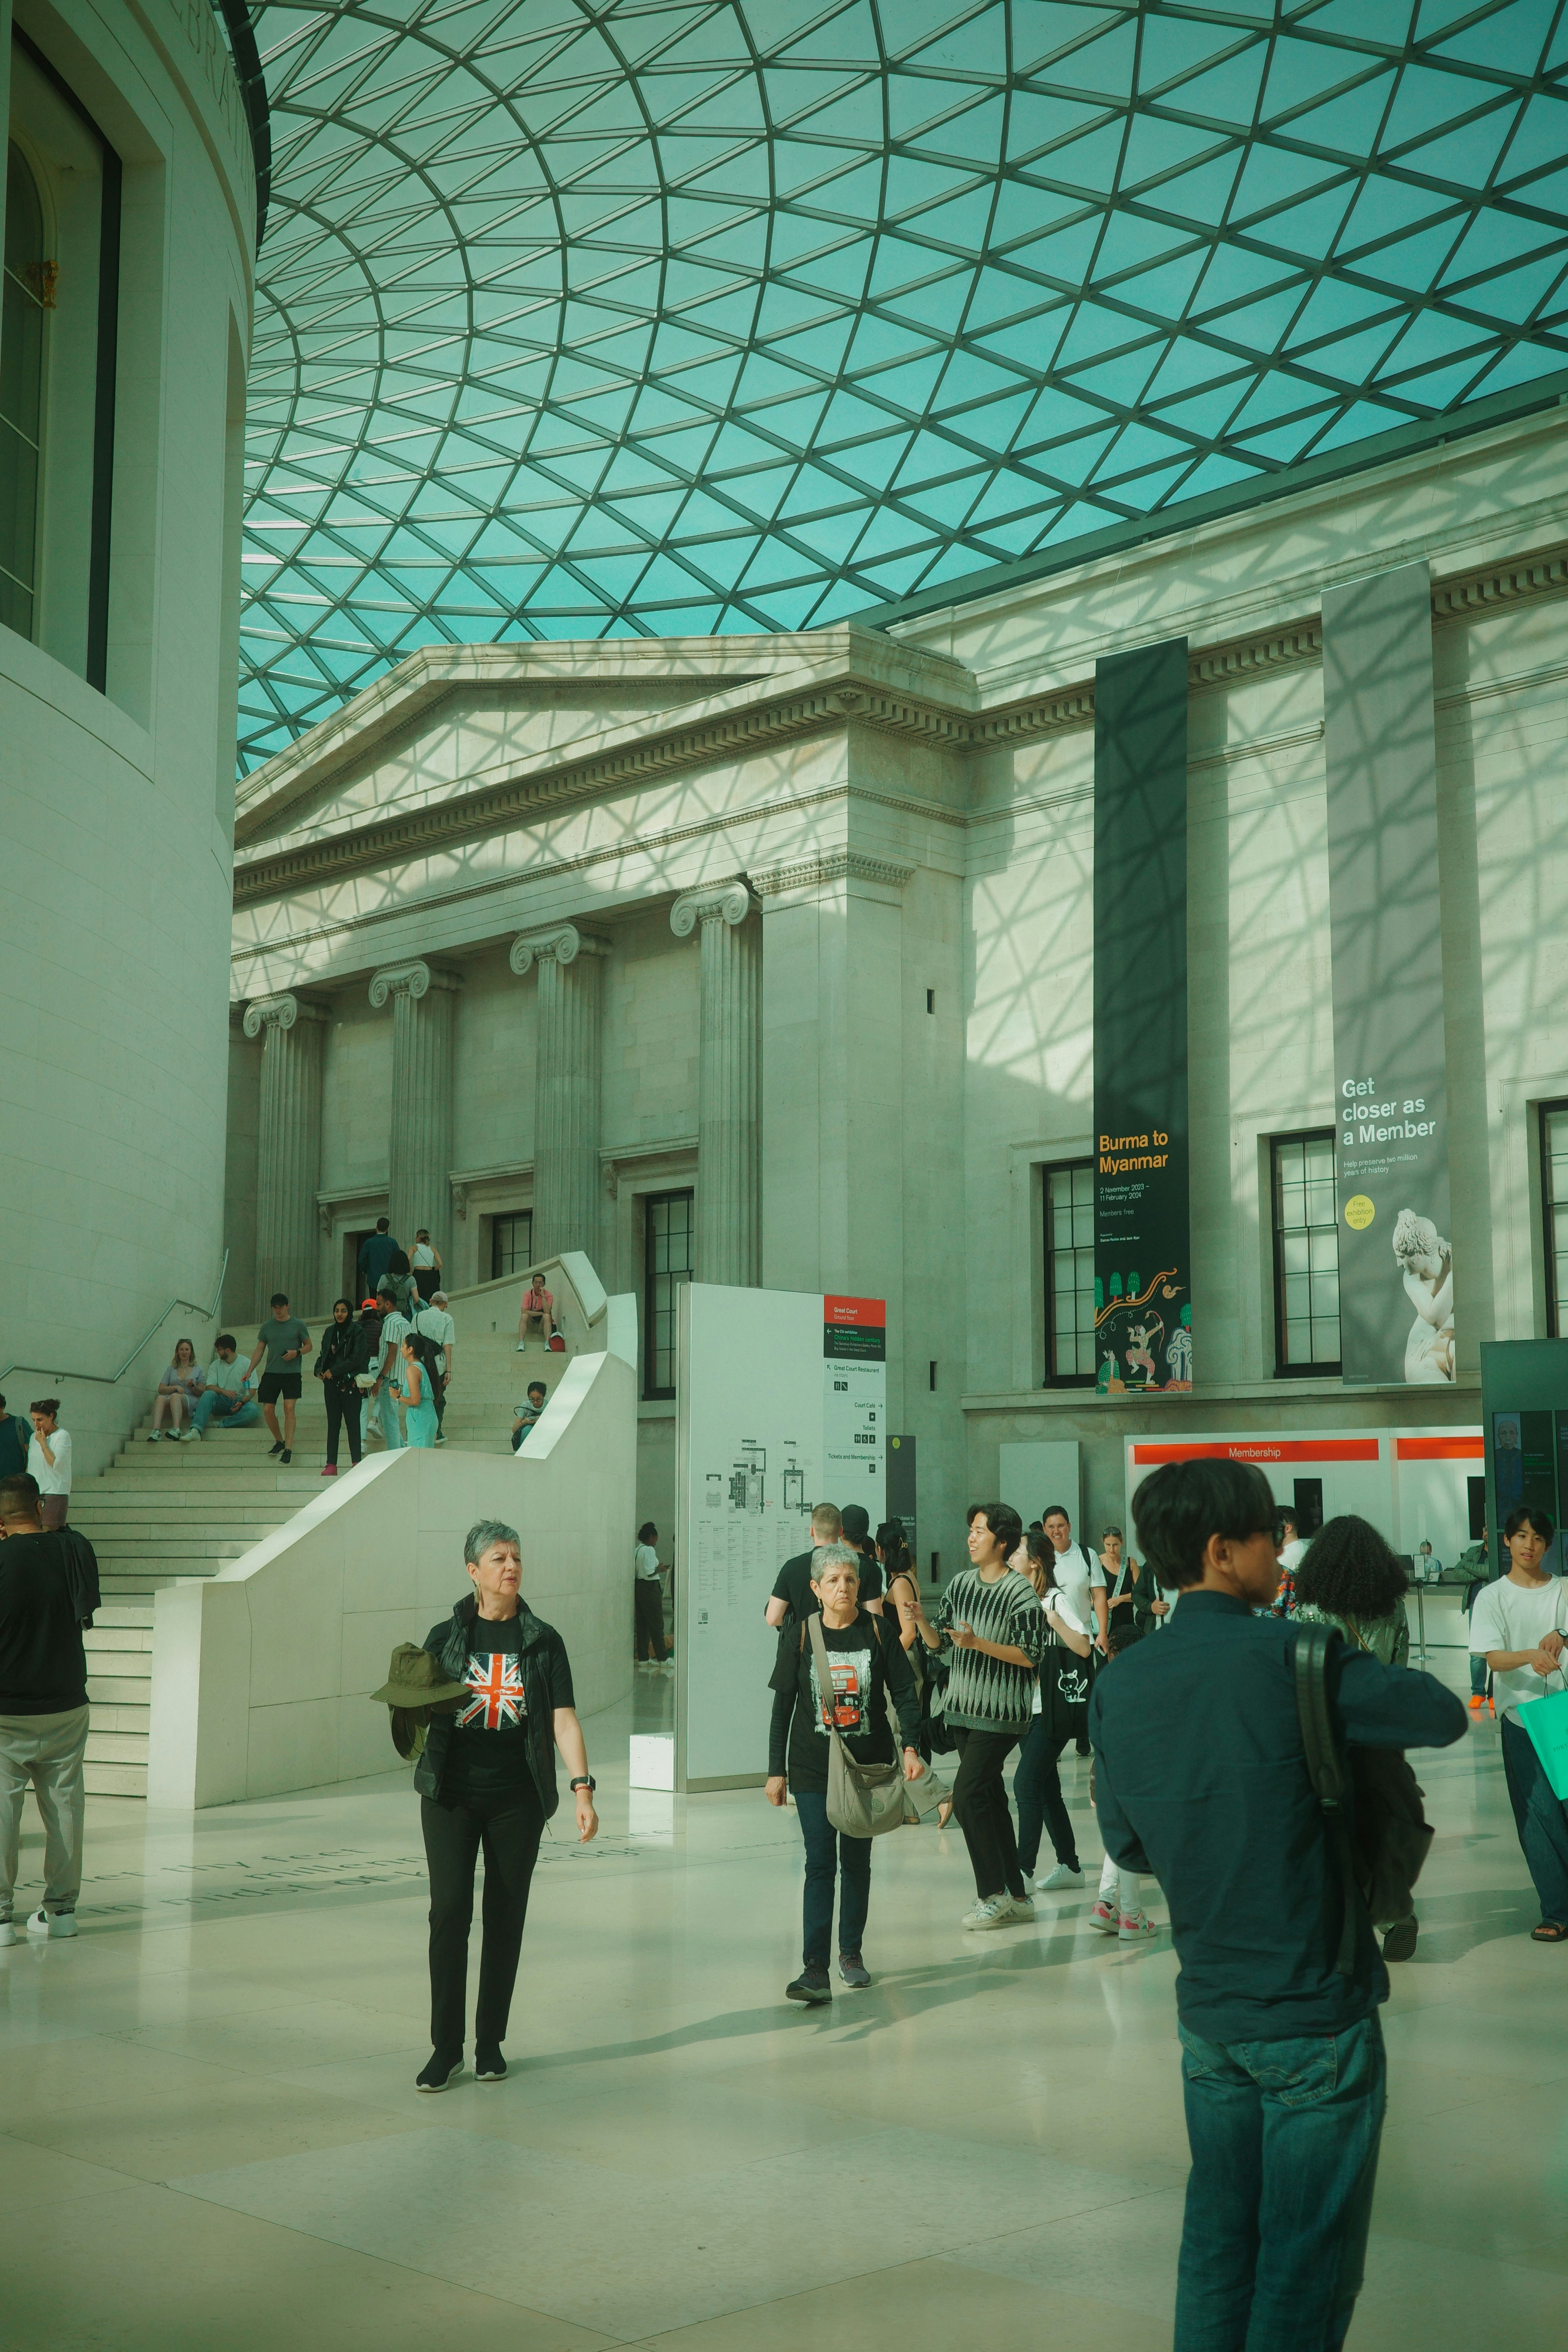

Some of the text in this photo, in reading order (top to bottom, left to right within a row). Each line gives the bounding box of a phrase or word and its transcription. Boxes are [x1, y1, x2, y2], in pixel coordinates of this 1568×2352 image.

[1343, 1078, 1375, 1098] Get
[1343, 1098, 1425, 1122] closer as
[1100, 1130, 1168, 1152] Burma to
[1343, 1120, 1436, 1145] a Member
[1100, 1154, 1168, 1176] Myanmar
[1344, 1160, 1357, 1169] Help
[1359, 1159, 1385, 1168] preserve
[1344, 1169, 1359, 1178] years
[1347, 1208, 1373, 1216] exhibition
[1229, 1446, 1281, 1459] Membership
[160, 1861, 251, 1873] thy
[261, 1849, 376, 1862] feet
[82, 1904, 152, 1915] in
[158, 1884, 325, 1906] midst
[334, 1875, 390, 1886] of
